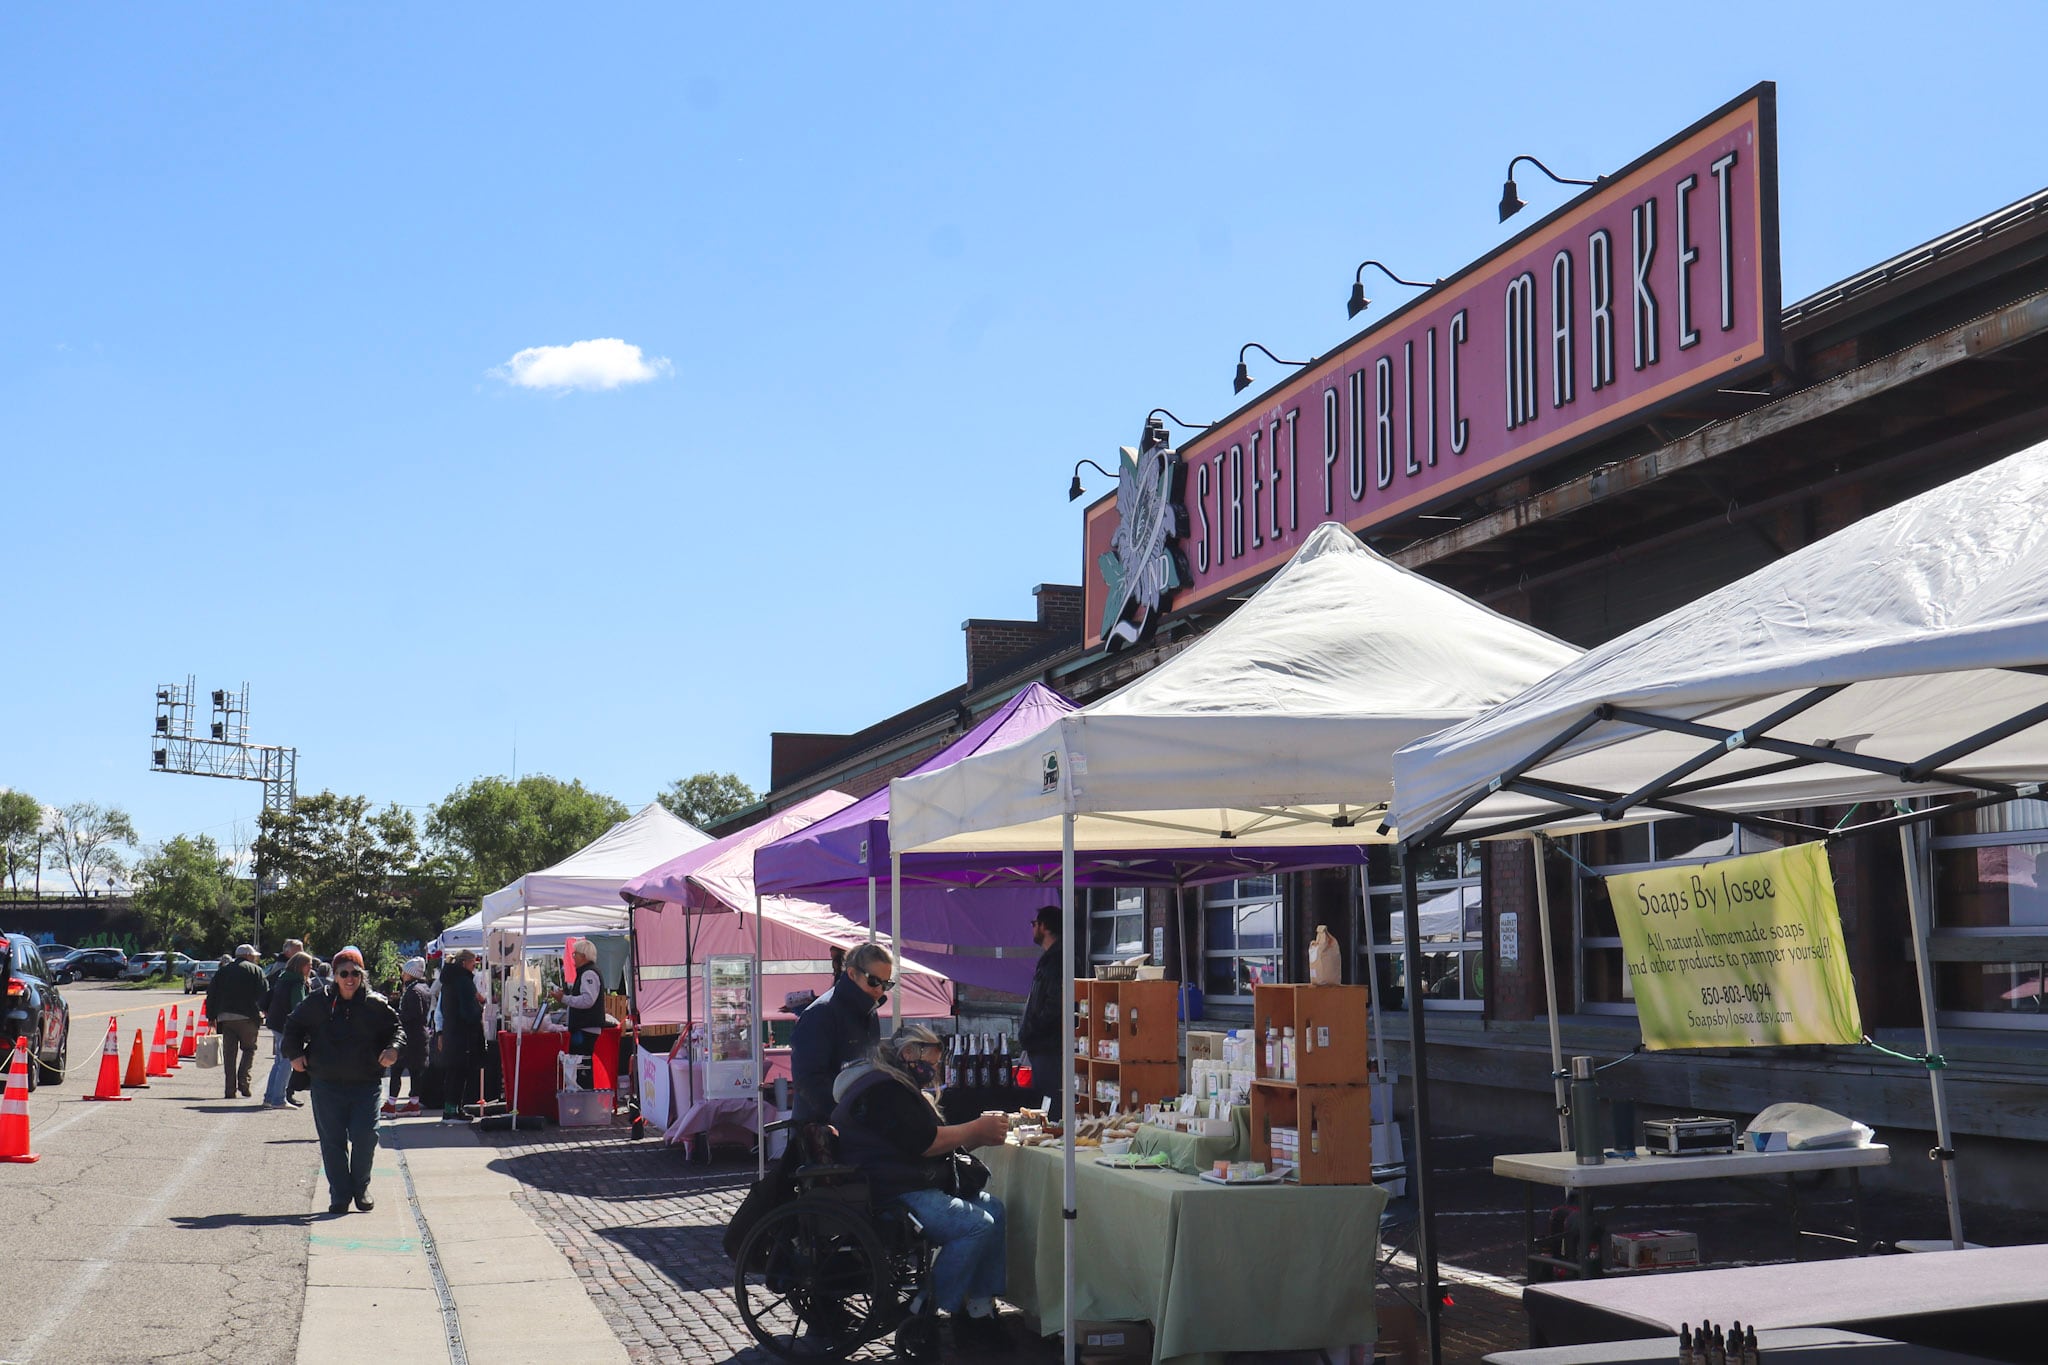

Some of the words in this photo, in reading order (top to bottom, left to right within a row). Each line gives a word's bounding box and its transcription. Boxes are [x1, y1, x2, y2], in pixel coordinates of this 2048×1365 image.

[1197, 407, 1299, 574] STREET
[1323, 308, 1468, 514] PUBLIC
[1504, 150, 1738, 430] MARKET
[1637, 882, 1689, 919] Soaps
[1690, 874, 1717, 914] By
[1721, 871, 1776, 912] Josee
[1647, 932, 1665, 952] All
[1666, 928, 1703, 950] natural
[1703, 921, 1767, 946] homemade
[1770, 922, 1805, 942] soaps
[1628, 956, 1648, 976] and
[1650, 953, 1677, 974] other
[1679, 950, 1725, 975] products
[1727, 952, 1739, 967] to
[1741, 946, 1785, 970] pamper
[1788, 937, 1832, 965] yourself!
[1701, 983, 1772, 1006] 850-803-0694
[1687, 1007, 1794, 1030] SoapsbyJosee.etsy.com
